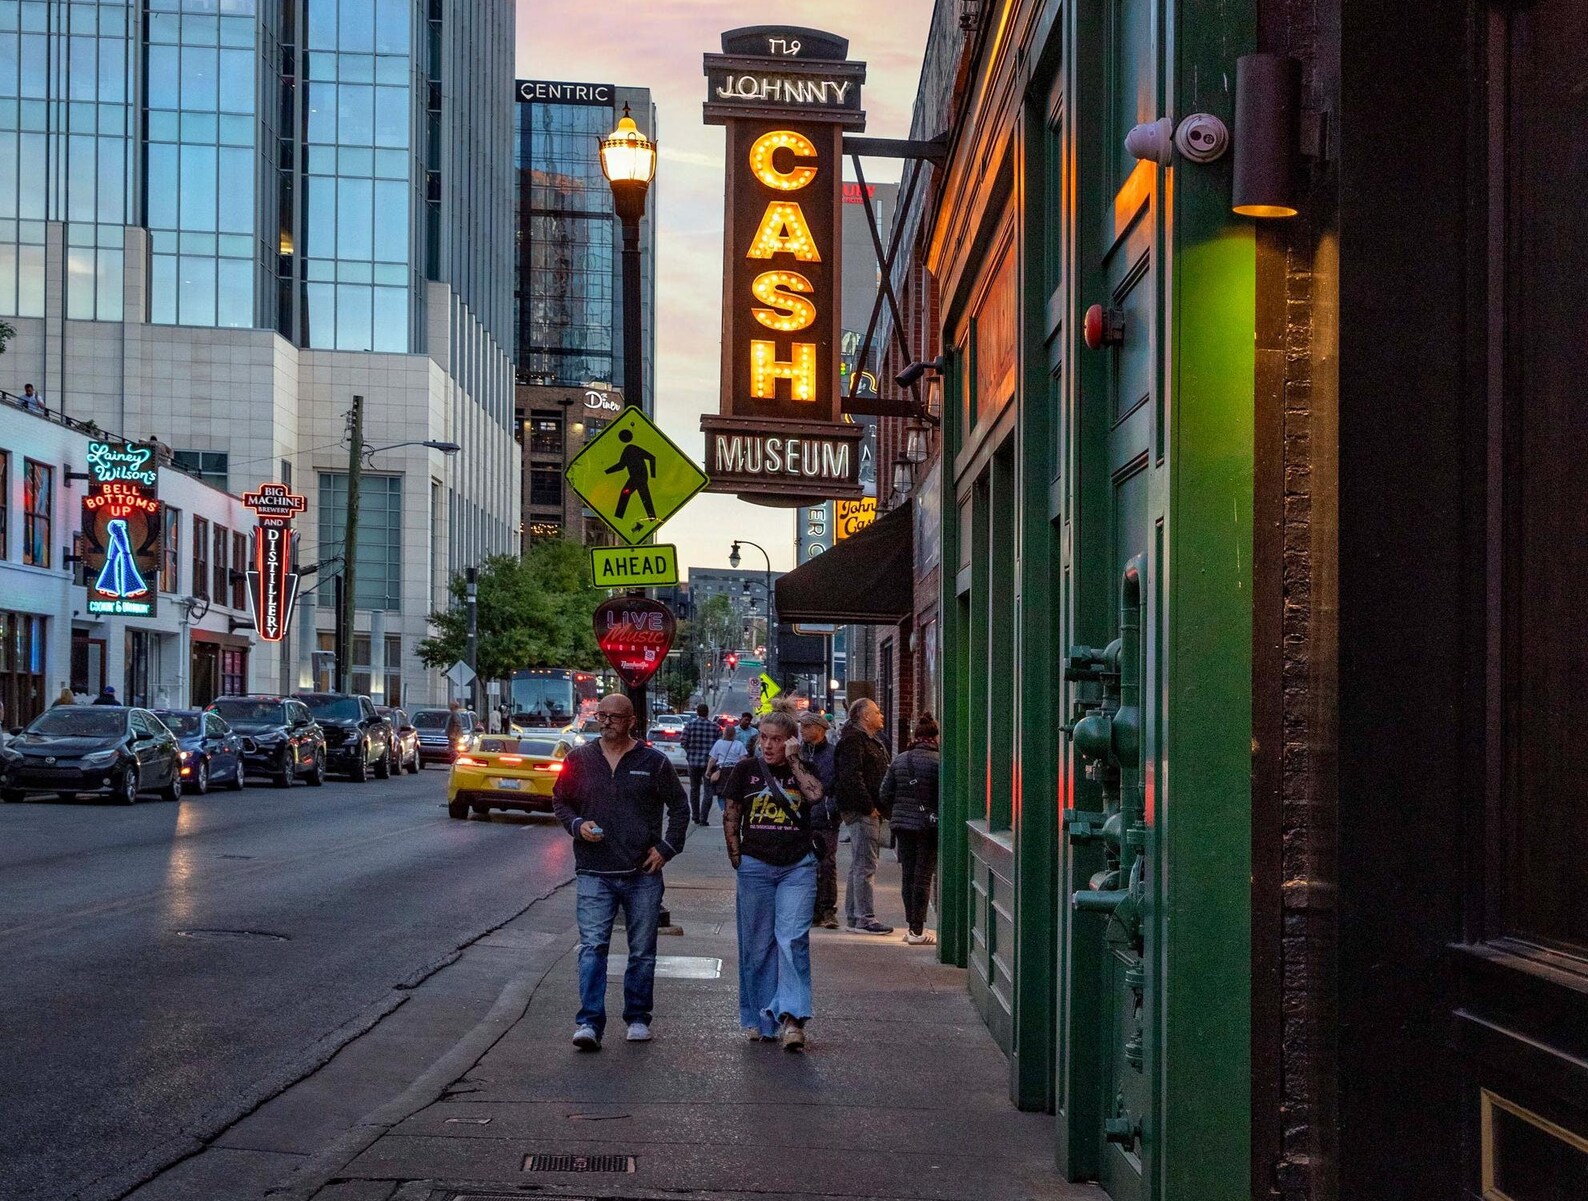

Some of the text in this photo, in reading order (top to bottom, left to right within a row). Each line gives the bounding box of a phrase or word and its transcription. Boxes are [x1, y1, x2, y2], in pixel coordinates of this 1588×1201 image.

[521, 83, 608, 101] CENTRIC
[717, 76, 850, 104] JOHNNY
[747, 130, 822, 401] CASH
[87, 443, 150, 470] Lainey
[716, 435, 849, 478] MUSEUM
[95, 466, 156, 485] Wilson's
[103, 484, 139, 495] BELL
[265, 487, 283, 496] BIG
[86, 494, 156, 512] BOTTOMS
[111, 506, 131, 516] UP
[248, 496, 300, 507] MACHINE
[603, 556, 666, 577] AHEAD
[267, 530, 279, 638] DISTILLERY
[607, 610, 663, 631] LIVE
[603, 622, 664, 643] Music
